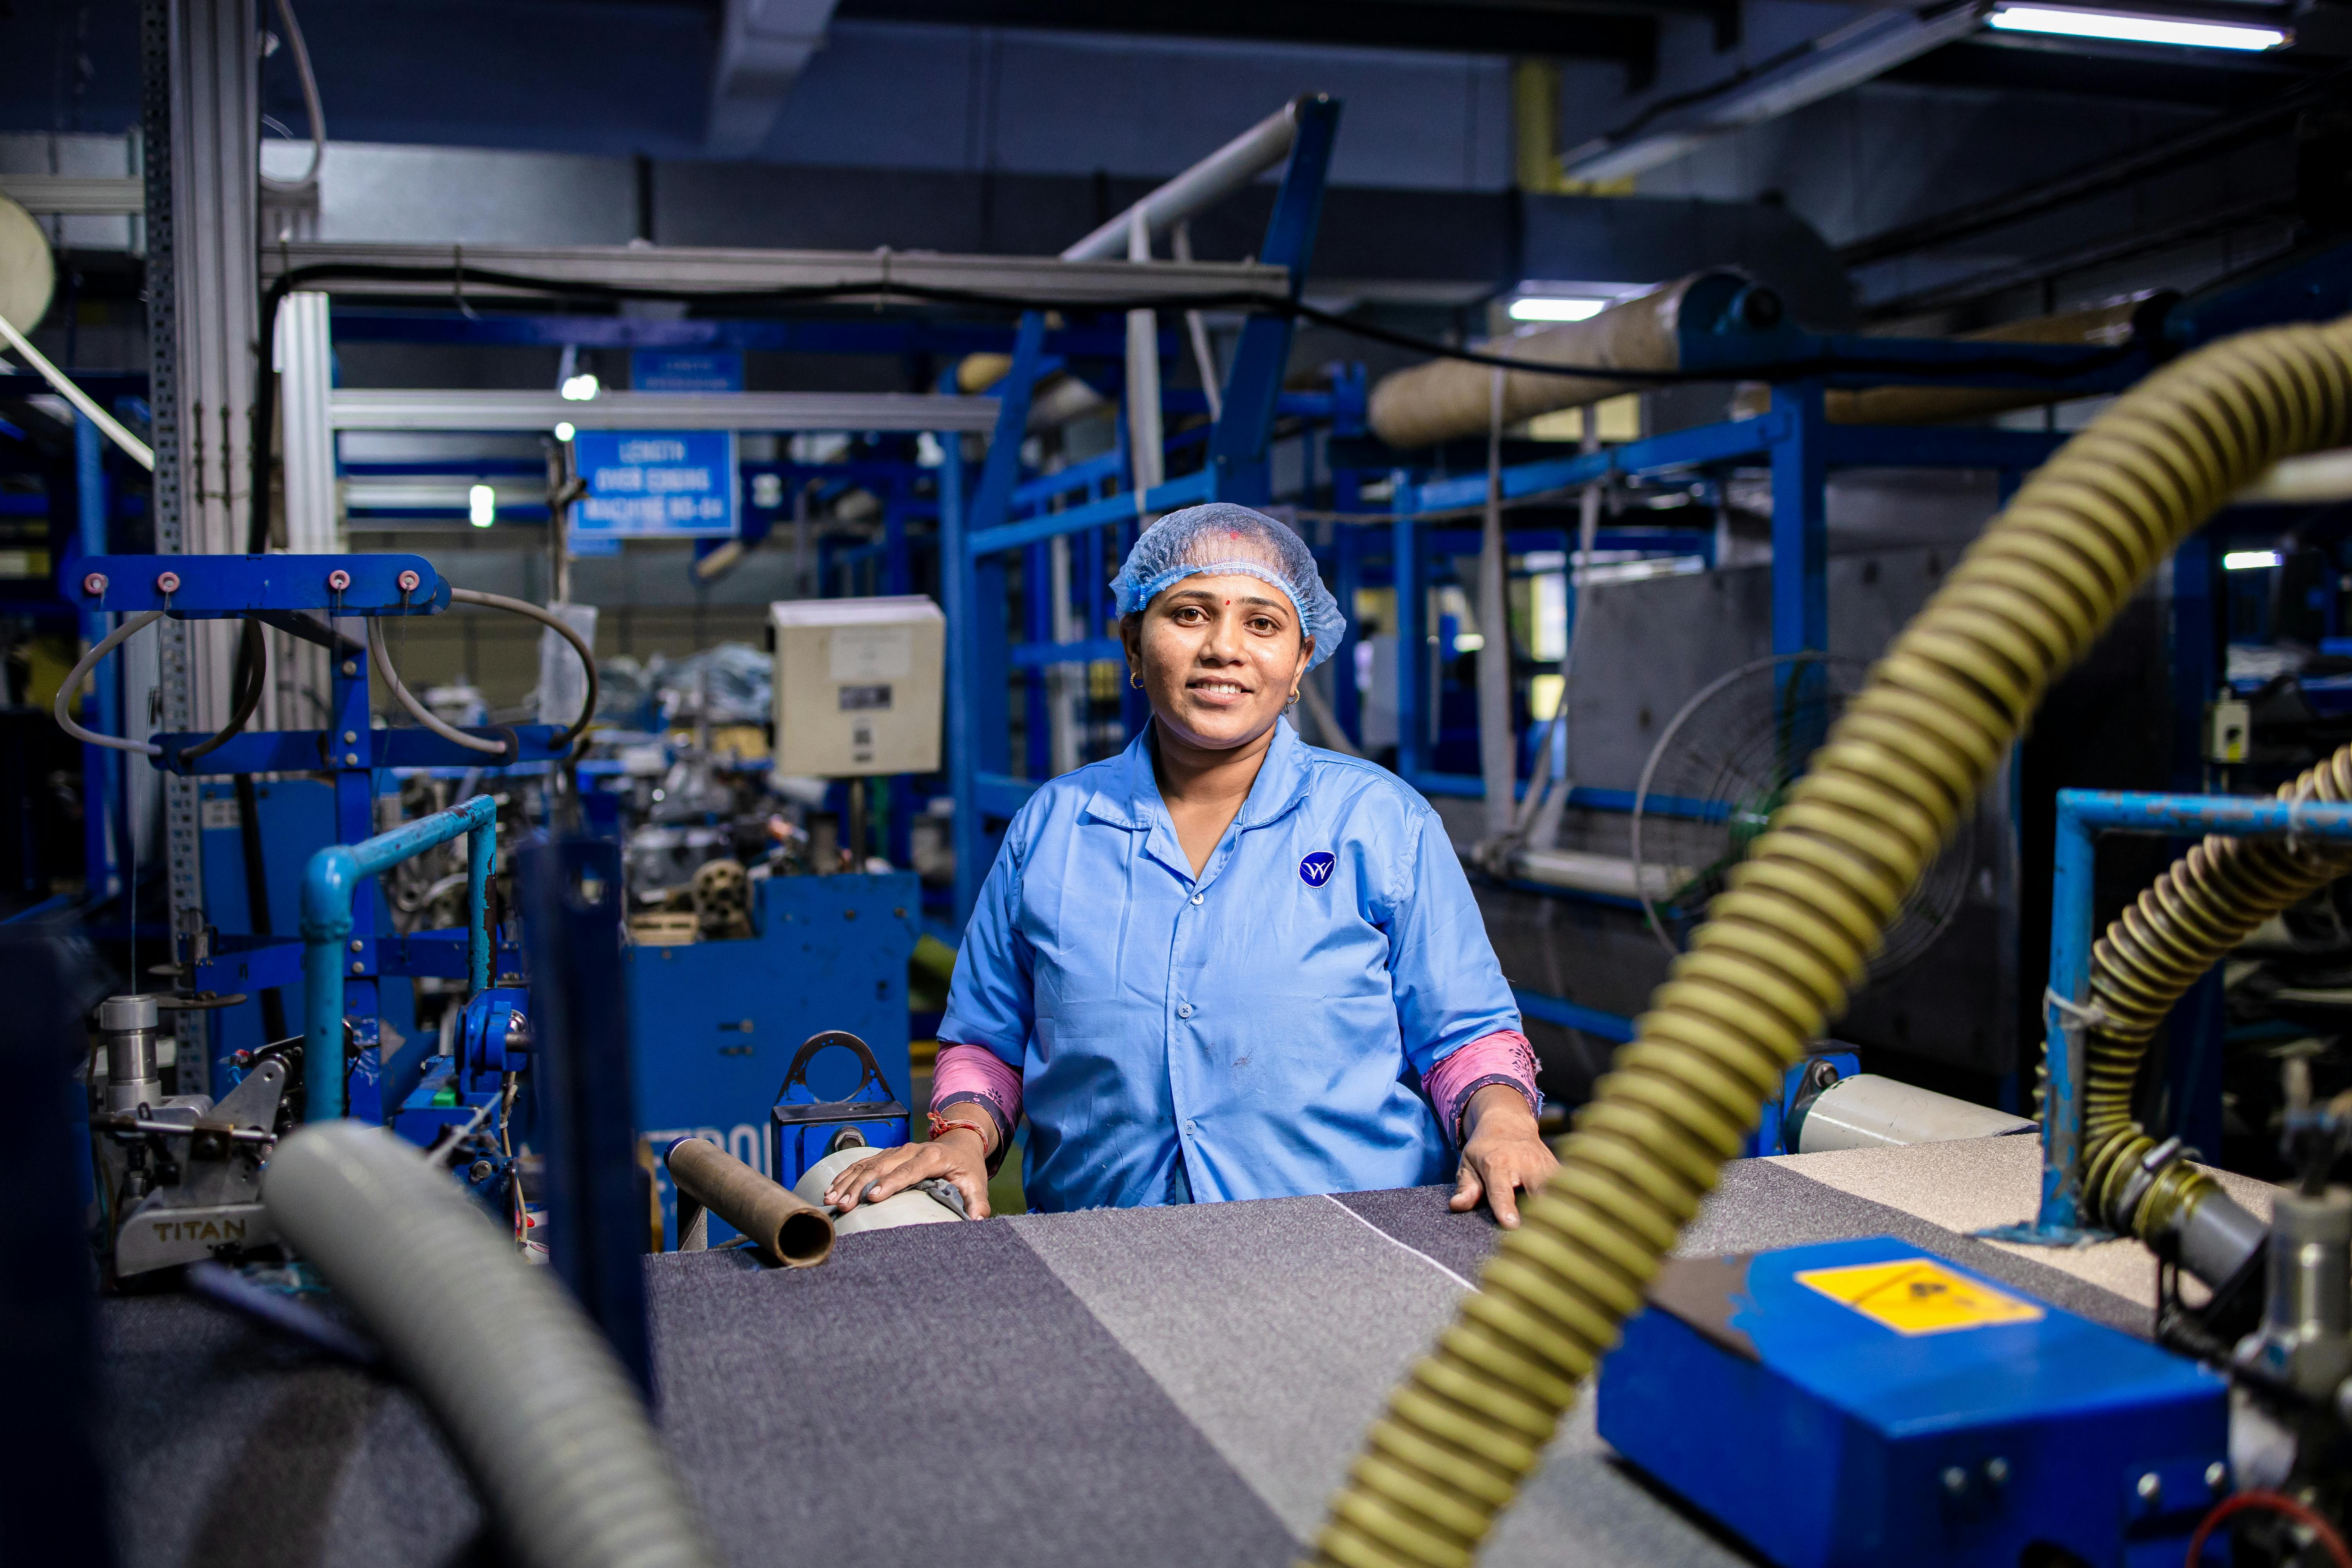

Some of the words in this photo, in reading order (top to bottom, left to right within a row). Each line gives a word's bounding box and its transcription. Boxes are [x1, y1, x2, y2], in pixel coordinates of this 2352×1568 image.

[620, 440, 685, 462] LENGTH
[585, 497, 664, 521] MACHINE
[153, 1219, 245, 1242] TITAN
